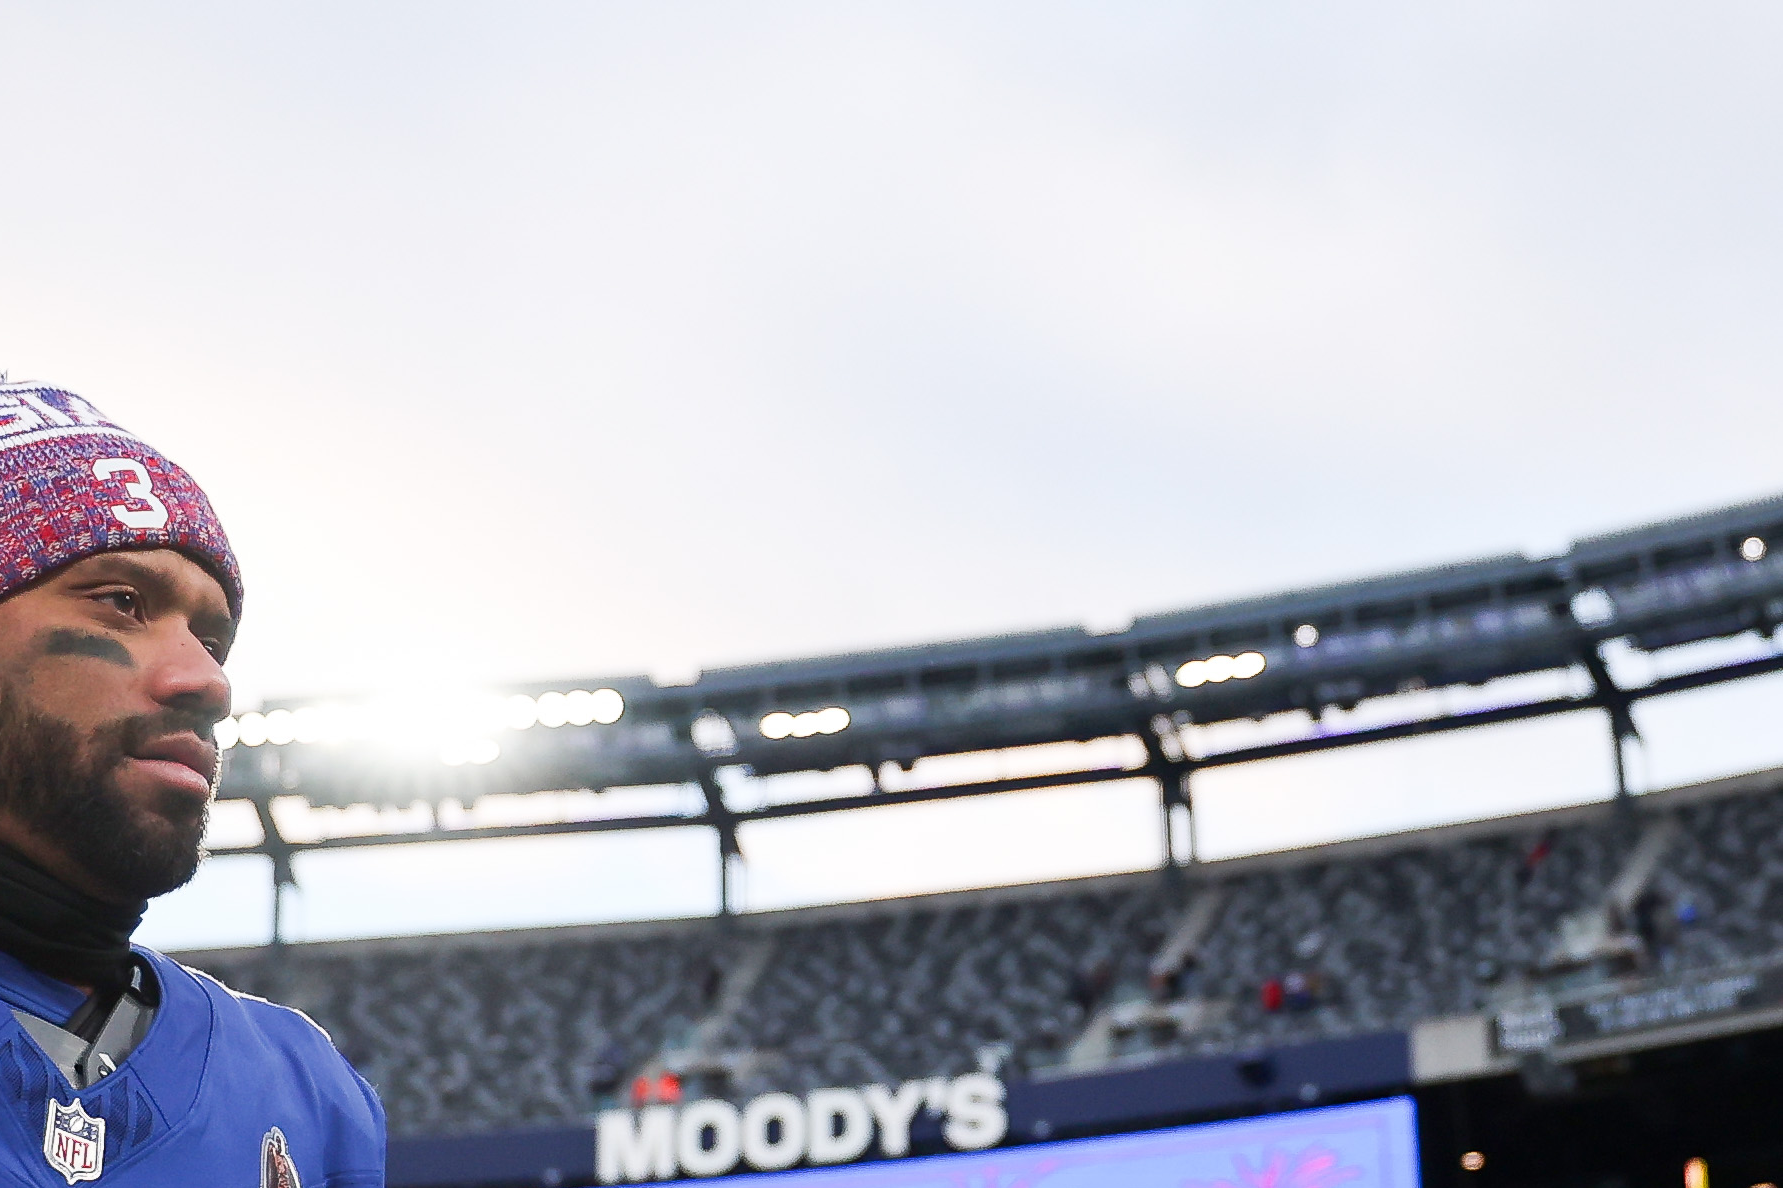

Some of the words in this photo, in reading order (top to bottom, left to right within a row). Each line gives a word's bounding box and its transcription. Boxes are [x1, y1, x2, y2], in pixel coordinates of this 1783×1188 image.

[91, 457, 169, 528] 3
[55, 1132, 93, 1170] NFL
[596, 1072, 1008, 1185] MOODY'S
